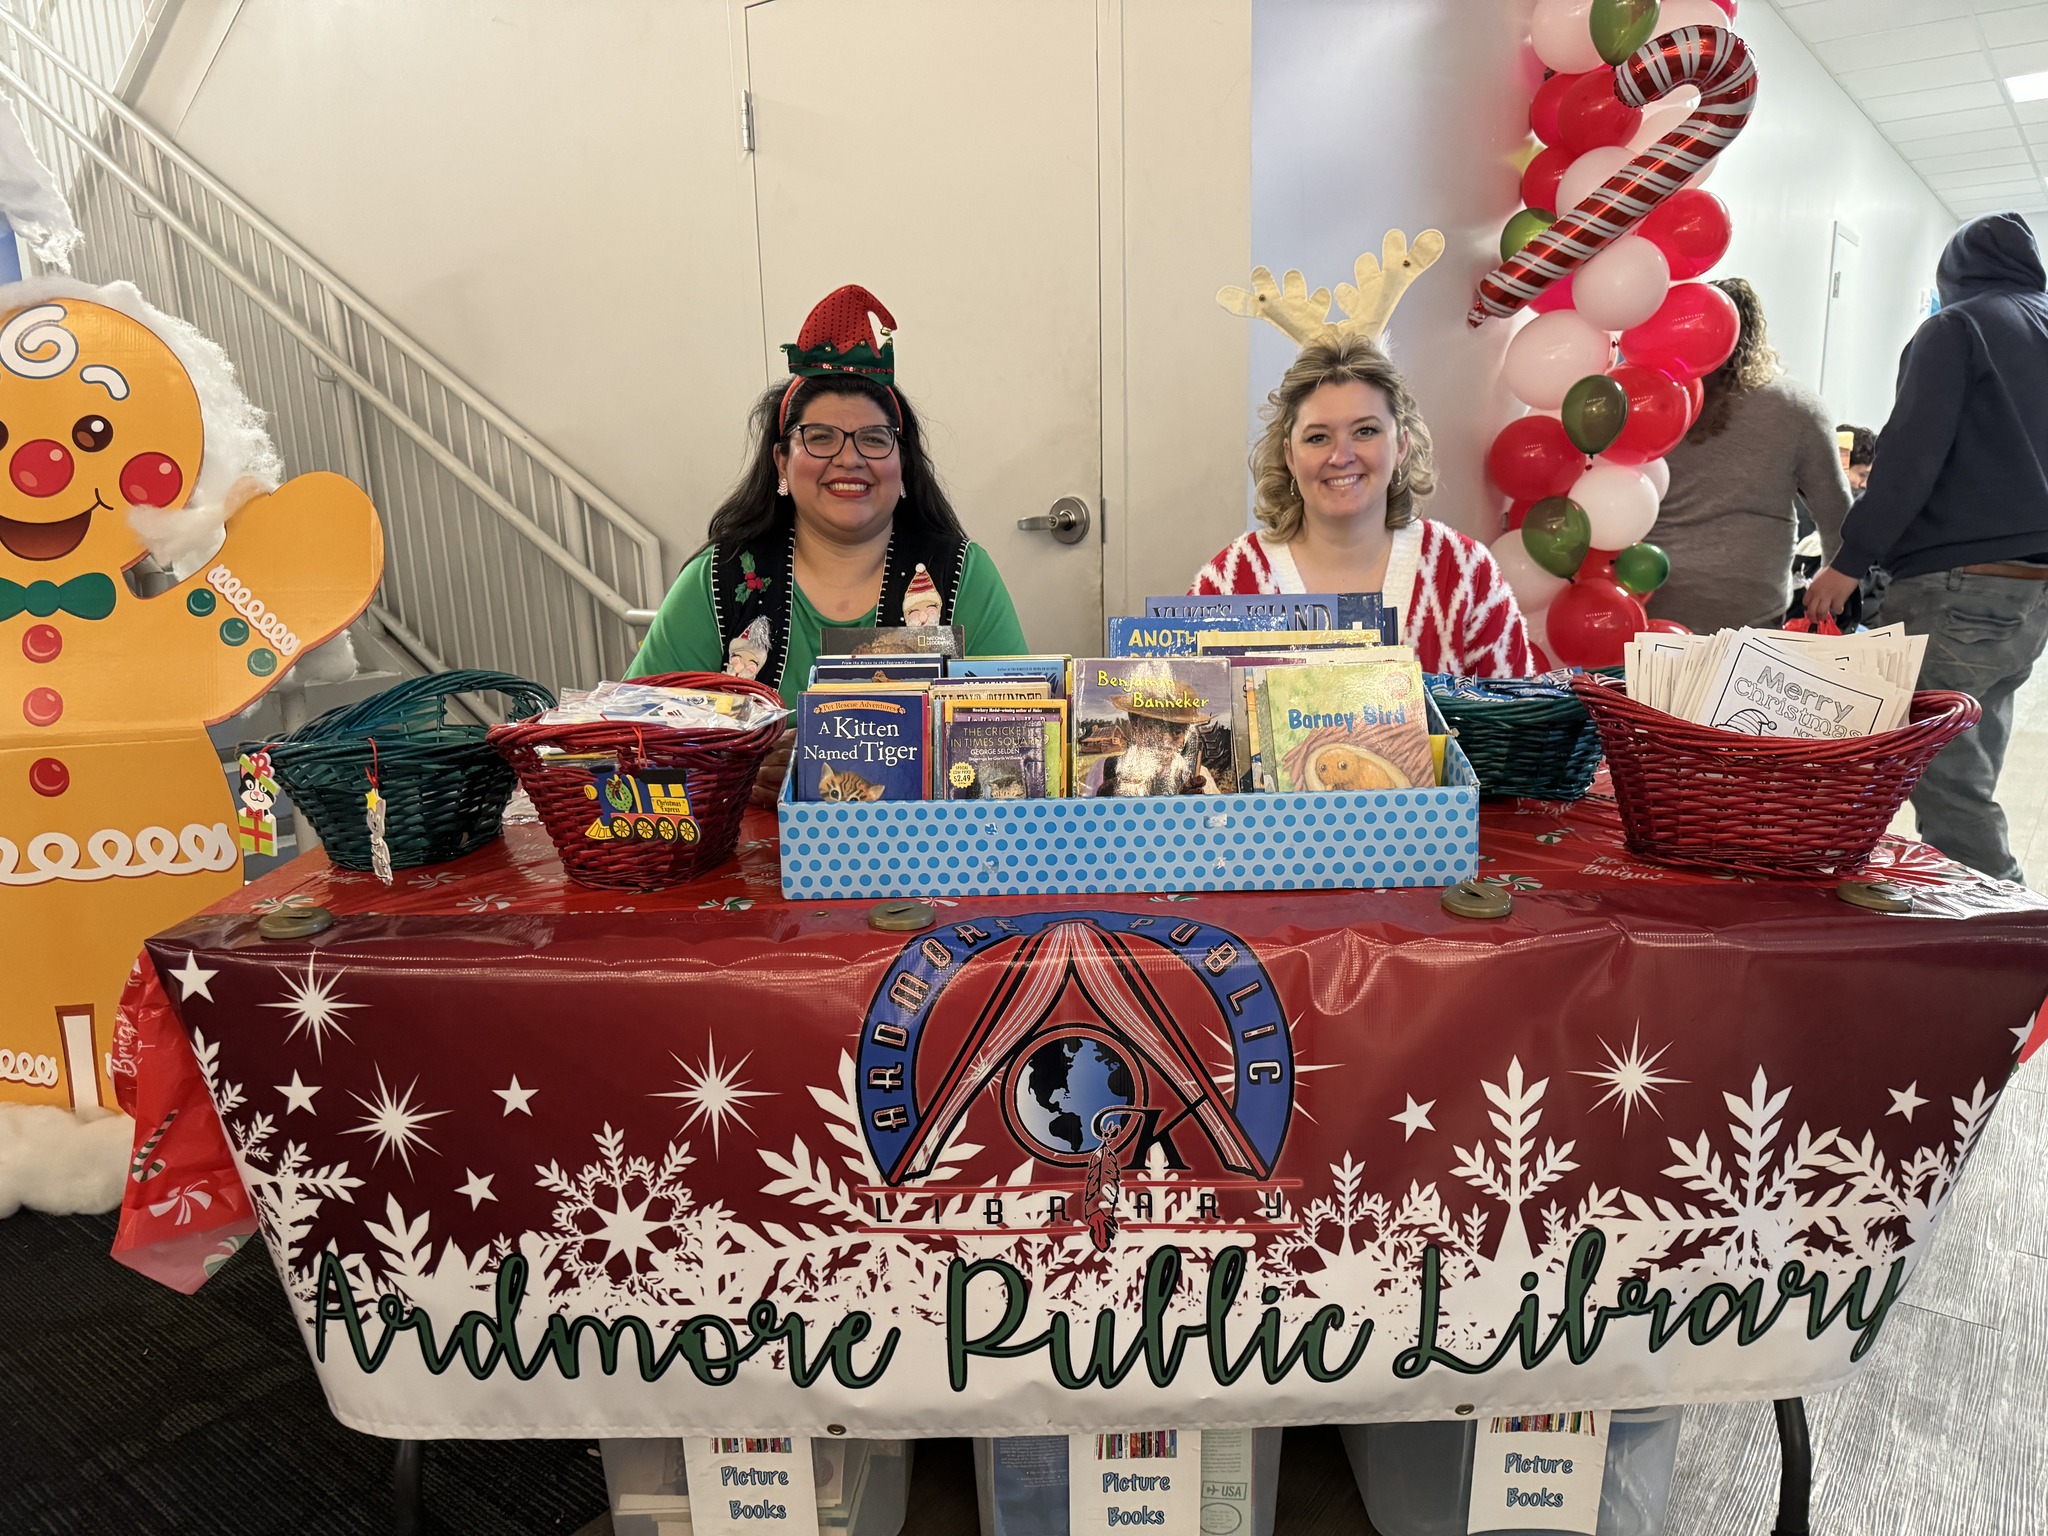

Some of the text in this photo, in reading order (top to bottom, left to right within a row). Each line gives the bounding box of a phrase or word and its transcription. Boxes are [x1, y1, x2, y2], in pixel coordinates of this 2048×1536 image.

[1128, 628, 1219, 648] ANOTH
[1133, 691, 1210, 708] Banneker
[1756, 665, 1855, 723] Merry
[835, 701, 858, 709] Rescue
[859, 701, 897, 711] Adventures
[818, 716, 900, 739] A Kitten
[1288, 703, 1407, 734] Barney Bird
[950, 736, 1042, 748] IN TIMES SQUAR
[963, 726, 1027, 737] THE CRICKET
[804, 740, 918, 767] Named Tiger
[970, 748, 996, 756] GEORGE
[656, 799, 682, 807] Christmas
[868, 917, 1284, 1133] ARDMORE PUBLIC
[876, 1191, 1282, 1226] LIBRARY
[315, 1228, 1907, 1392] Ardmore Public Library
[1504, 1452, 1574, 1474] Picture
[720, 1466, 789, 1487] Picture
[1102, 1472, 1171, 1493] Picture
[1221, 1485, 1242, 1497] USA
[1506, 1487, 1564, 1507] Books
[729, 1499, 787, 1520] Books
[1107, 1505, 1165, 1527] Books
